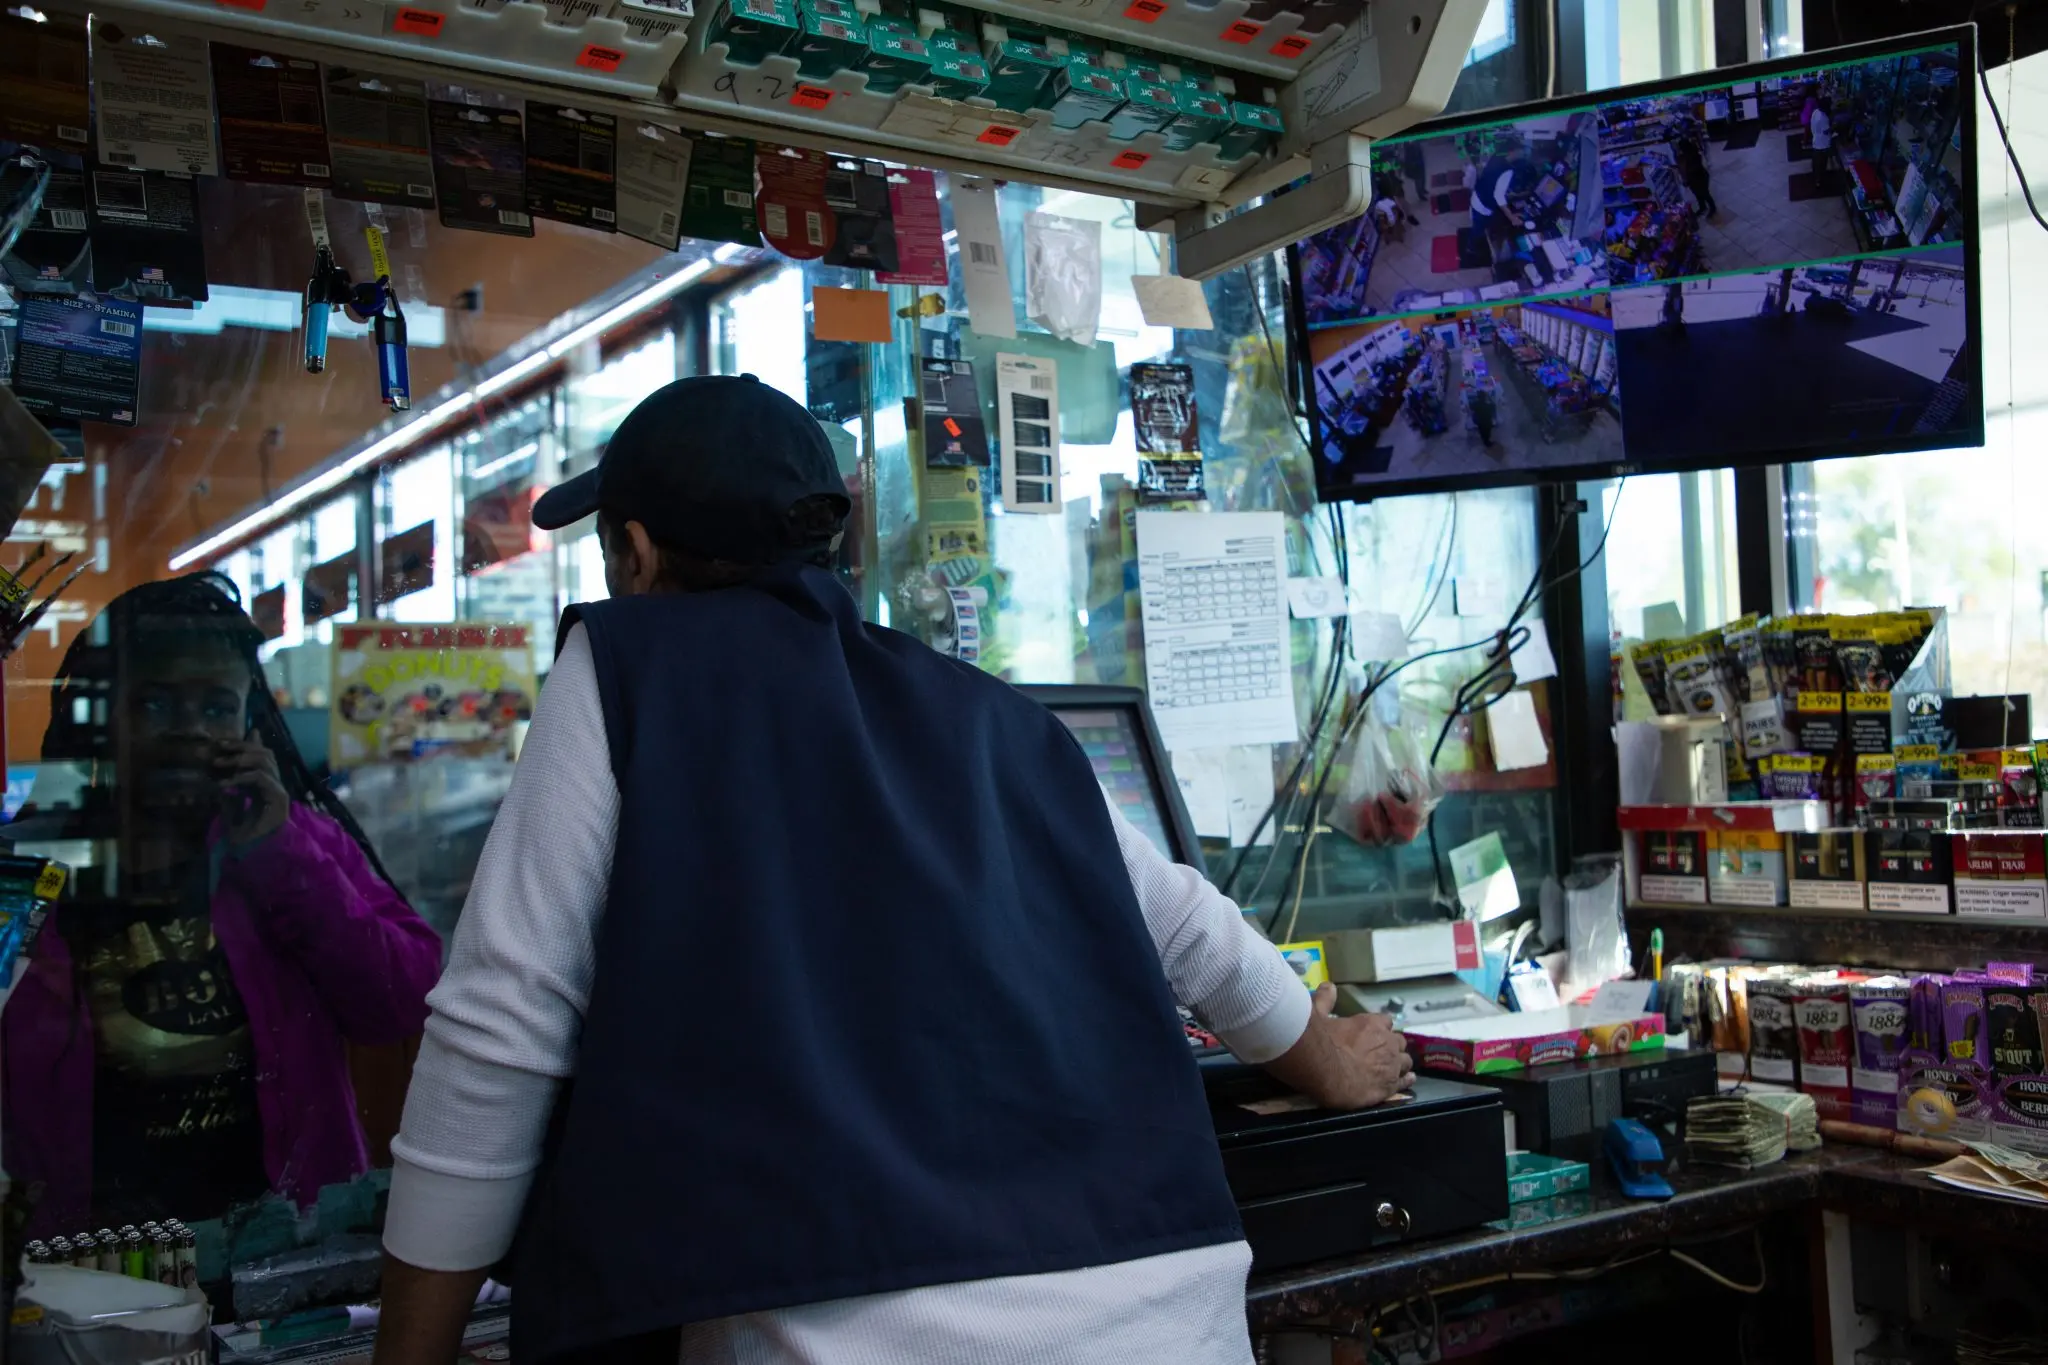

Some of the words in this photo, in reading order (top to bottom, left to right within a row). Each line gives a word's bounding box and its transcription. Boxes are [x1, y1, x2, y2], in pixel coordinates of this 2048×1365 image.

[94, 304, 137, 319] STAMINA
[340, 627, 527, 649] FRESH
[364, 650, 504, 693] DONUTS
[1907, 692, 1943, 714] OPTIMO
[1753, 1006, 1782, 1022] 1882
[1806, 1010, 1839, 1024] 1882
[1868, 1013, 1907, 1030] 1882
[1923, 1068, 1958, 1083] HONEY
